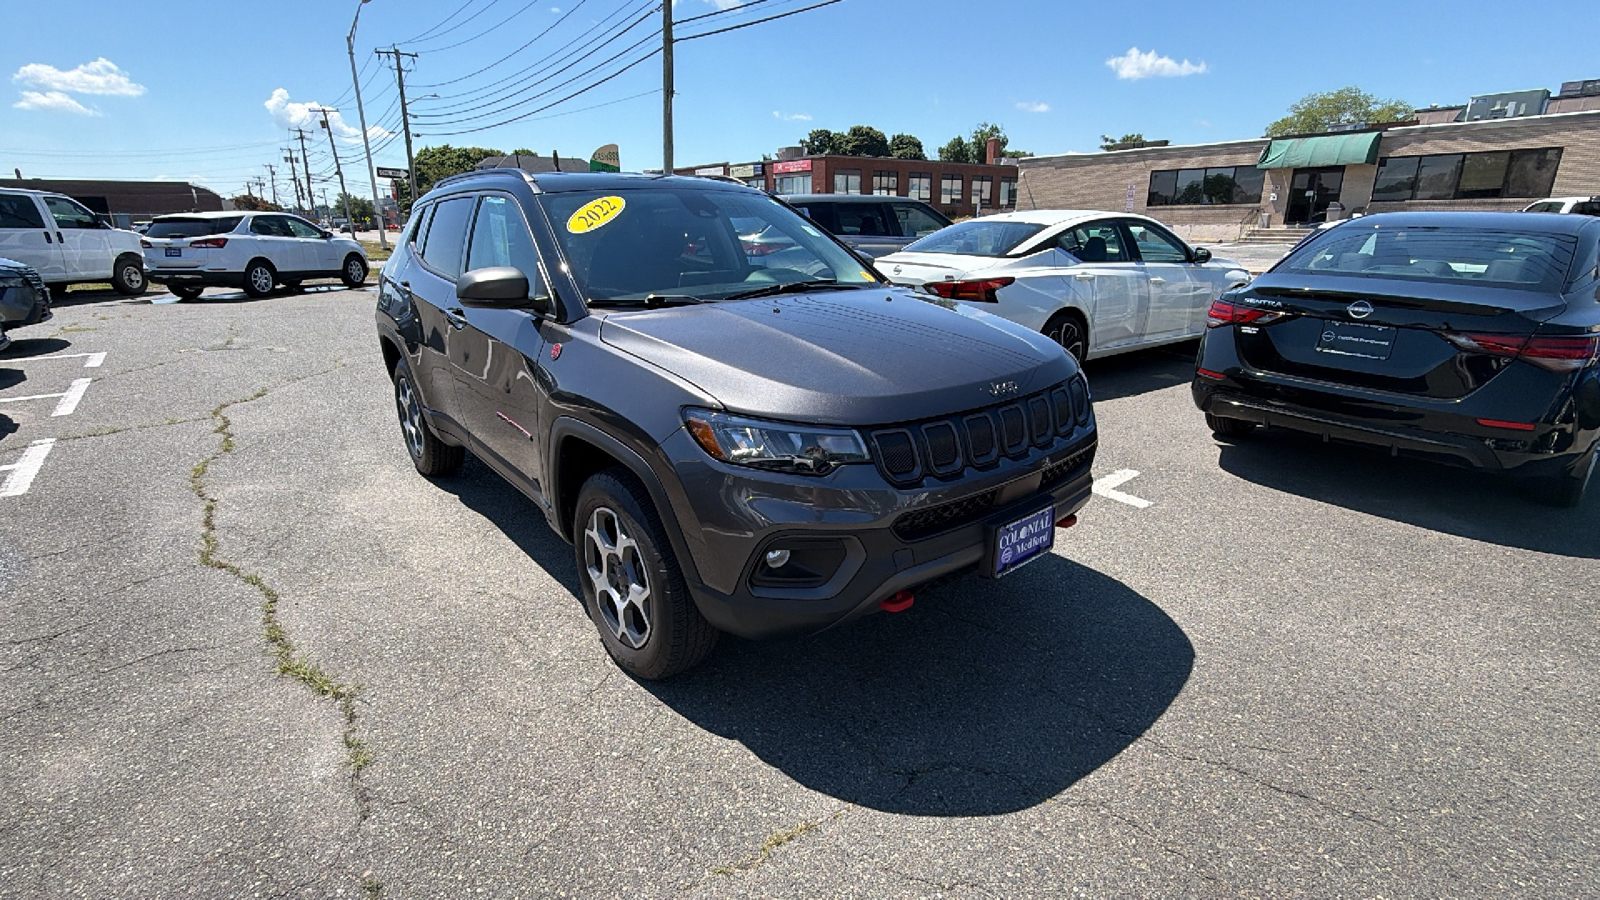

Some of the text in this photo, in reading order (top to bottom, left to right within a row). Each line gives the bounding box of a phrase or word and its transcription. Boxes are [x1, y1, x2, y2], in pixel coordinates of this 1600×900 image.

[577, 199, 618, 228] 2022
[1244, 297, 1283, 308] SENTRA
[1337, 335, 1359, 343] Certified
[999, 515, 1052, 550] COLONIAL
[1015, 531, 1049, 555] Medford
